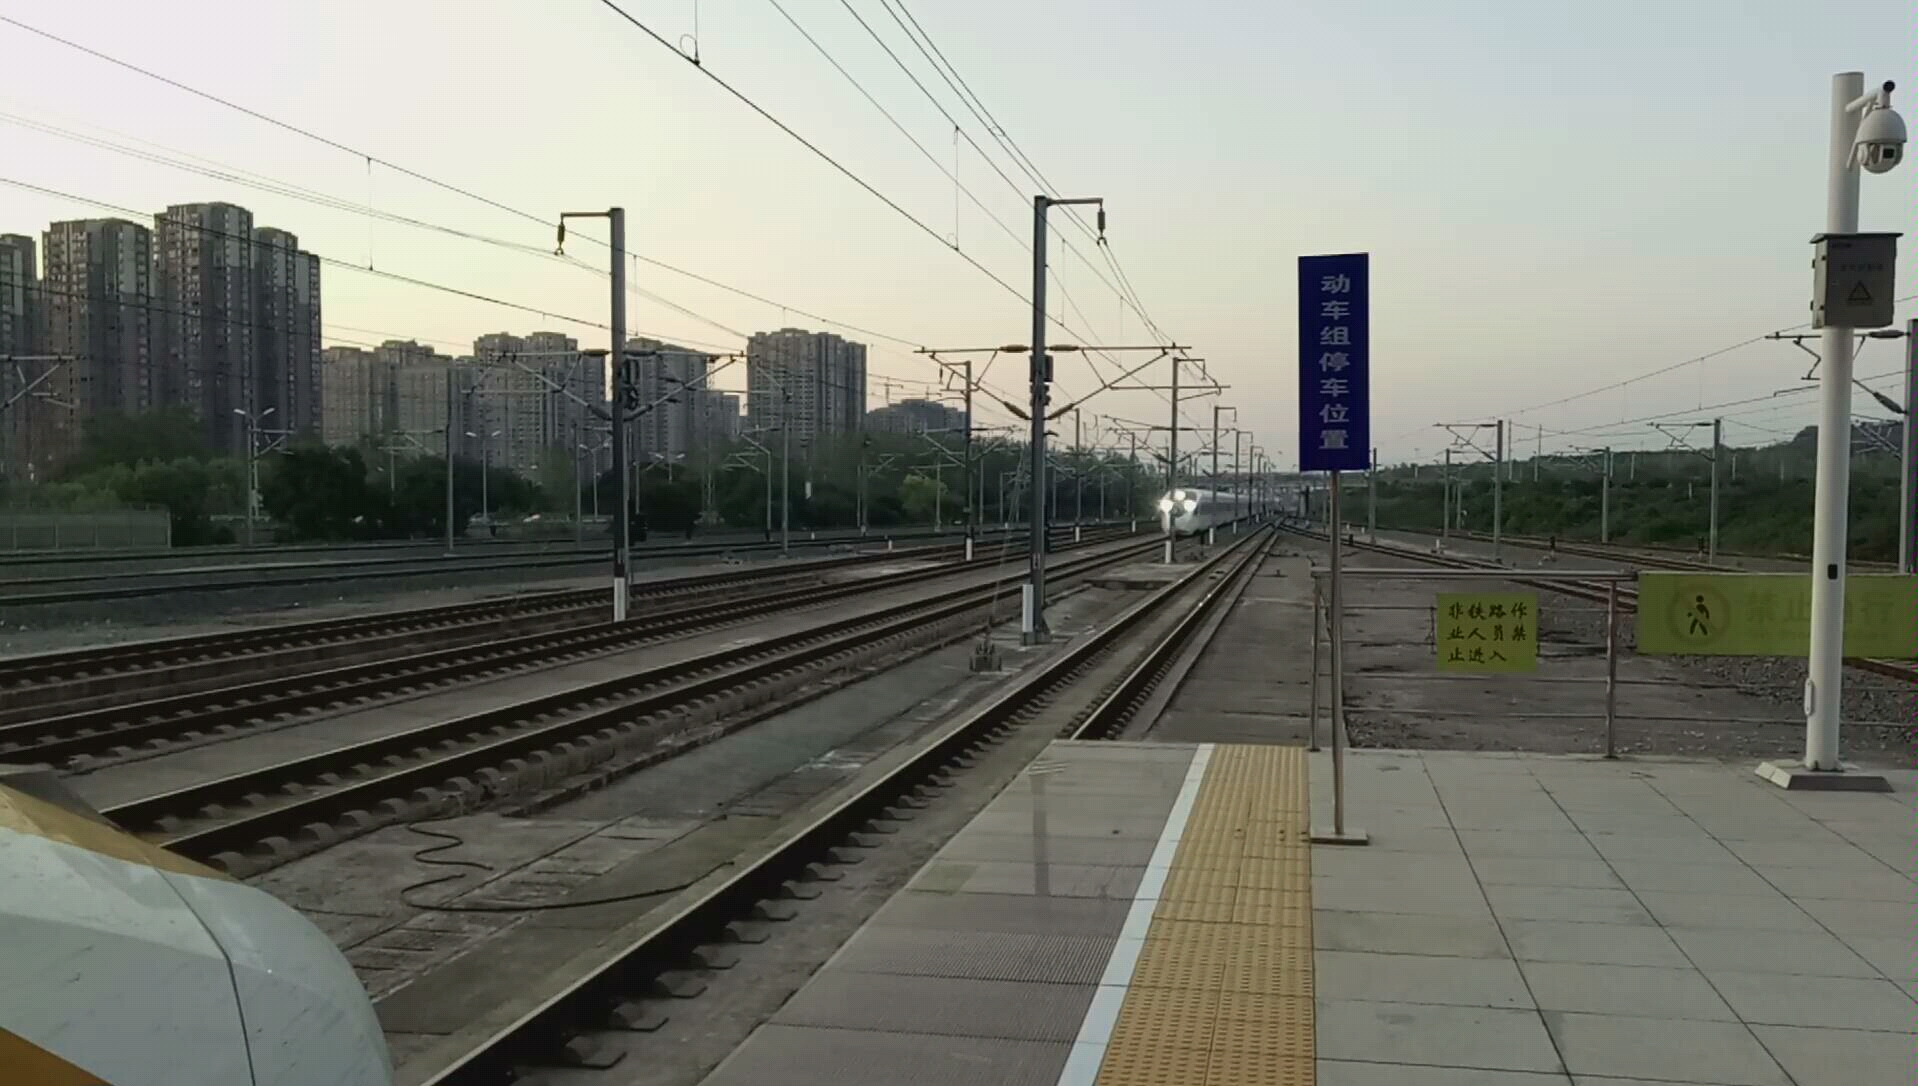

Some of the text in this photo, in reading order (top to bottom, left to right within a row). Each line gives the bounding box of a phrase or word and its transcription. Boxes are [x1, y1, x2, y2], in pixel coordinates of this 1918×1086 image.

[1318, 273, 1351, 449] 动车组停车位置
[1448, 602, 1527, 620] 非铁路作
[1745, 591, 1894, 624] 禁止行
[1446, 624, 1527, 641] 业人员禁
[1448, 646, 1507, 664] 止进入
